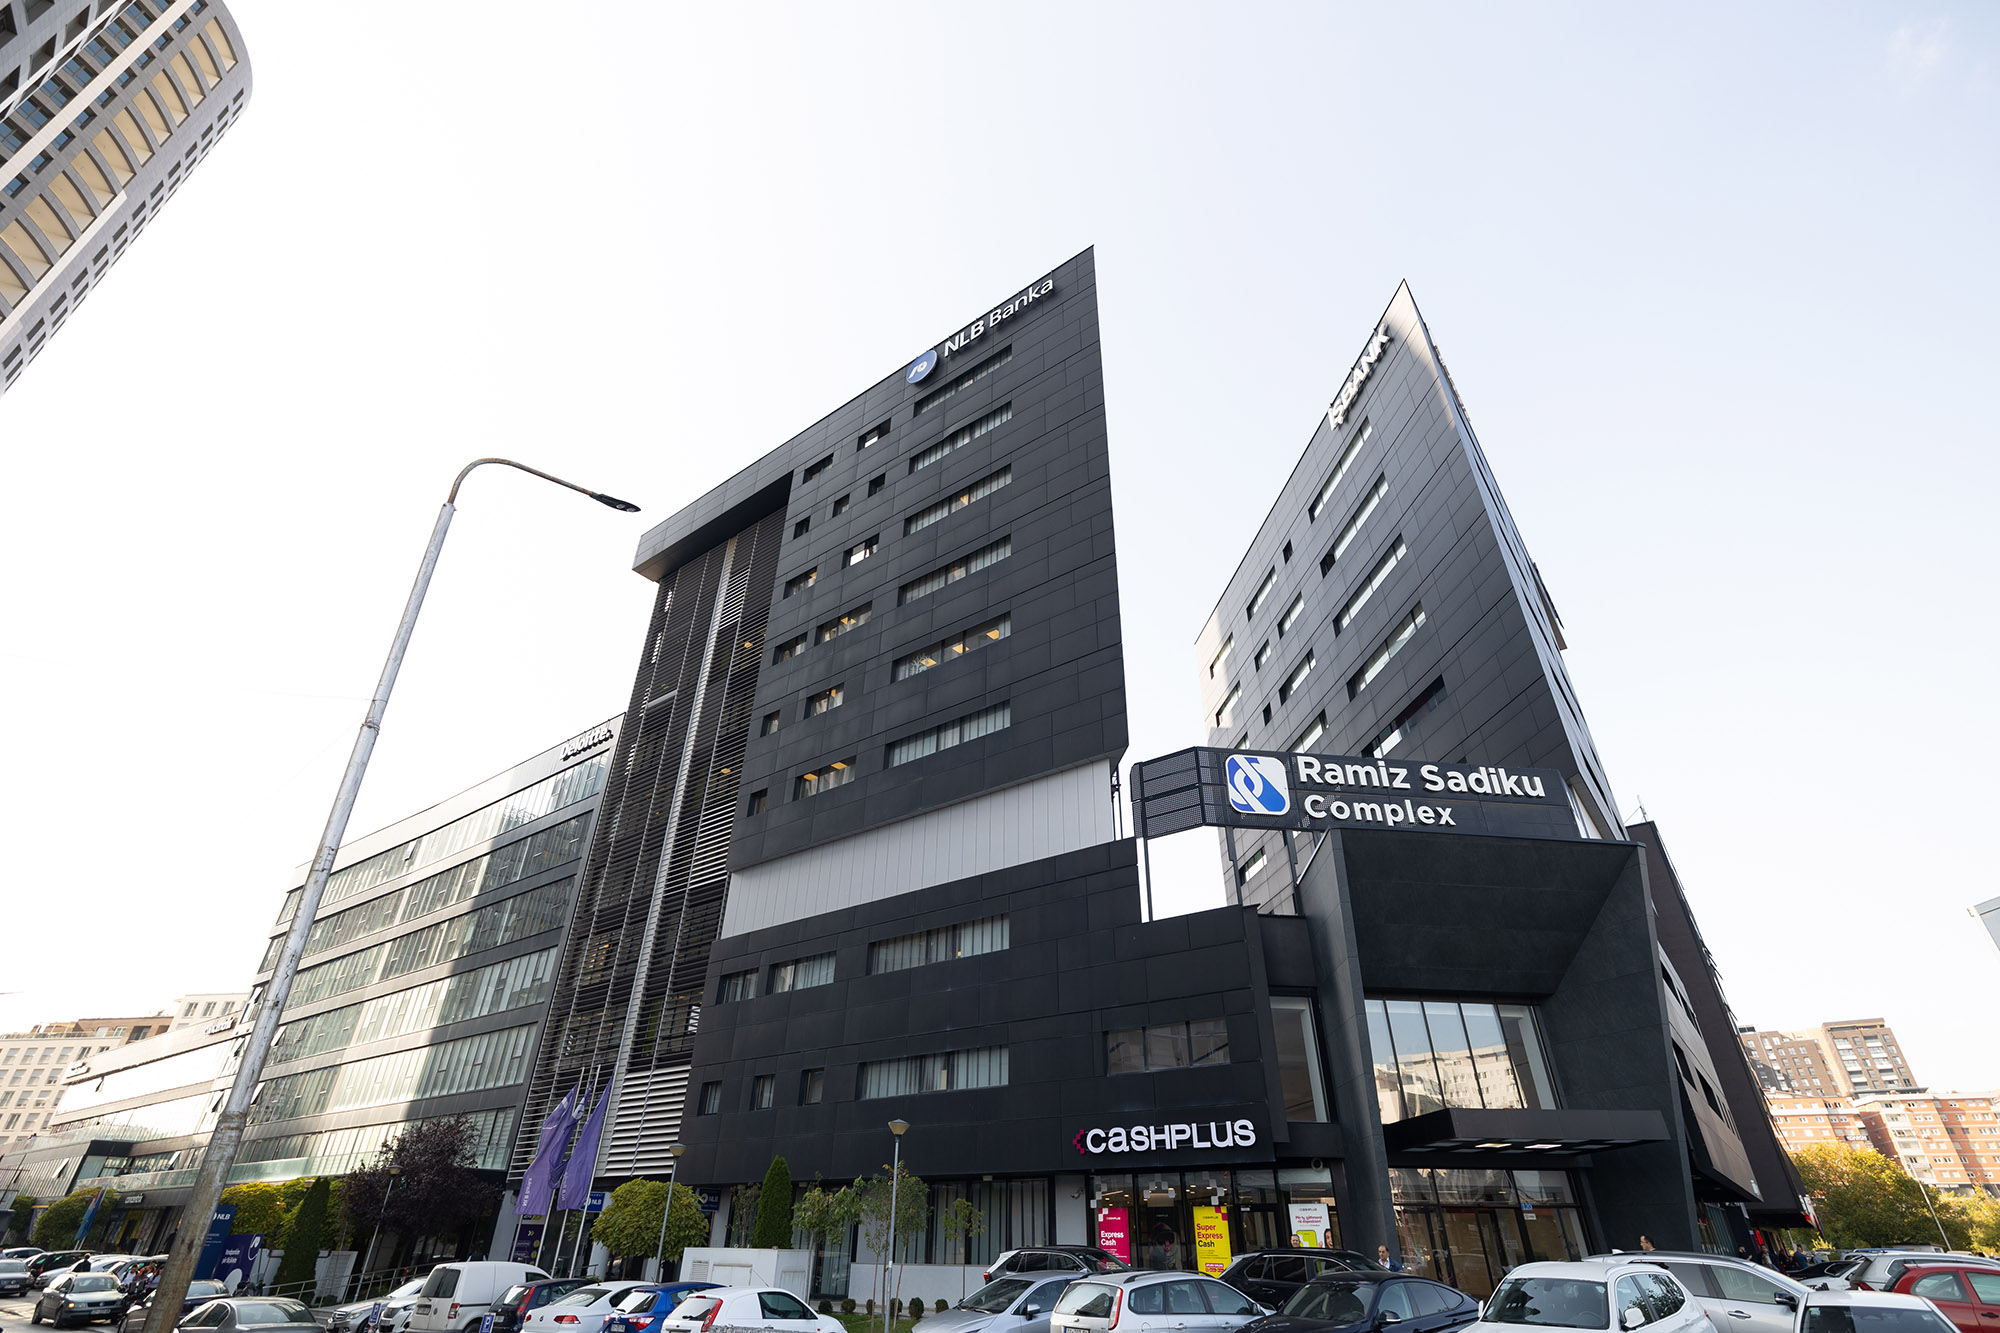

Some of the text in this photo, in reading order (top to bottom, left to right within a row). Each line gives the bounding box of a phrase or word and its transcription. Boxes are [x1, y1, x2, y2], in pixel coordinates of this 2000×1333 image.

[944, 279, 1053, 357] NLB Banka
[1296, 755, 1546, 797] Ramiz Sadiku
[1304, 794, 1456, 827] Complex
[1196, 1223, 1216, 1232] Super
[1100, 1230, 1125, 1239] Express
[1197, 1231, 1223, 1240] Express
[1100, 1238, 1117, 1246] Cash
[484, 1317, 491, 1329] P
